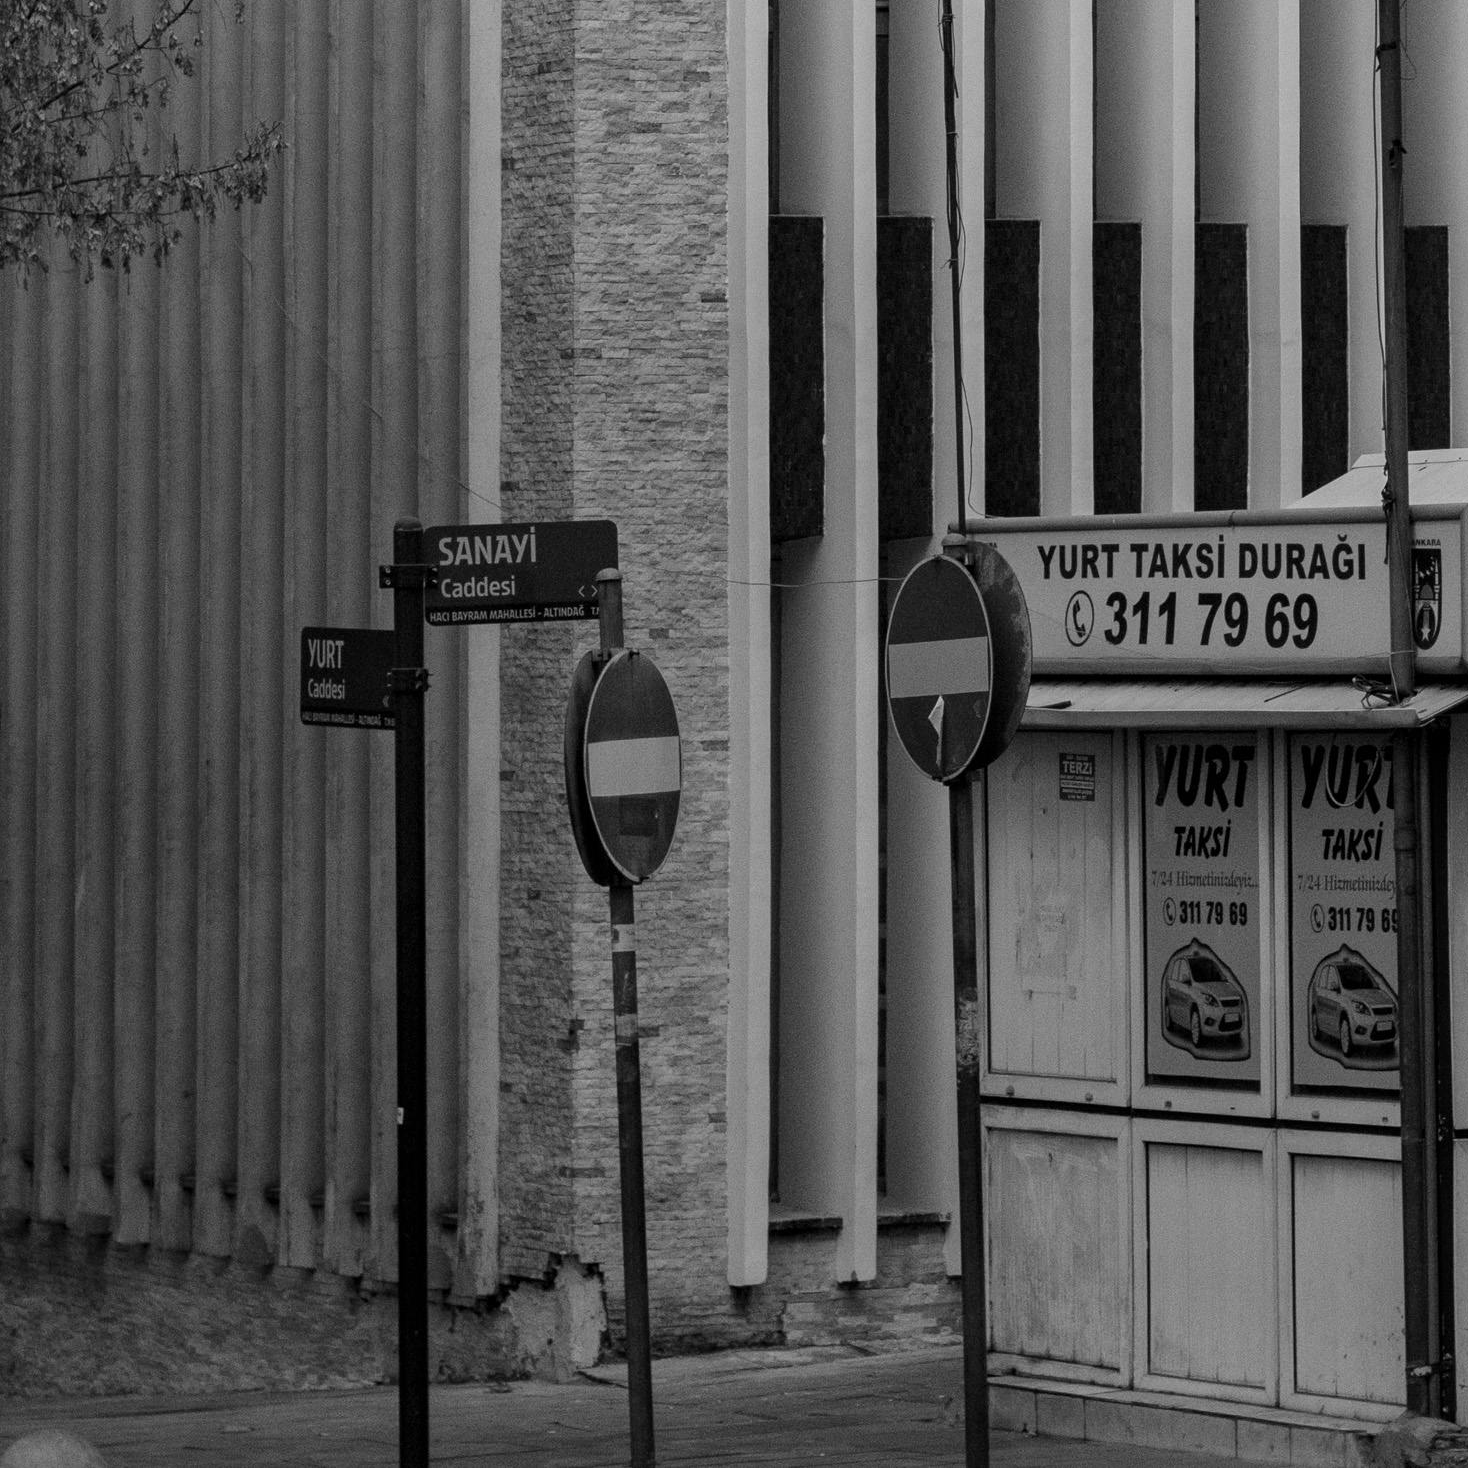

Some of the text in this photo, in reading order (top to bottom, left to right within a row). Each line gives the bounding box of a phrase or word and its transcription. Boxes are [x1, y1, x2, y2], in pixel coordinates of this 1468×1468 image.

[438, 526, 537, 566] SANAYİ
[1037, 534, 1366, 581] YURT TAKSİ DURAĞI
[440, 575, 516, 599] Caddesi
[430, 612, 450, 622] HACI
[451, 610, 488, 622] BAYRAM
[489, 605, 536, 620] MAHALLESİ
[543, 604, 585, 618] ALTINDAĞ
[1104, 591, 1319, 650] 311 79 69
[308, 638, 344, 669] YURT
[308, 678, 345, 700] Caddesi
[1155, 744, 1255, 813] YURT
[1174, 819, 1232, 859] TAKSİ
[1322, 821, 1383, 862] TAKSİ
[1151, 870, 1173, 887] 7/24
[1179, 900, 1248, 927] 311 79 69
[1328, 907, 1399, 933] 311 79 69
